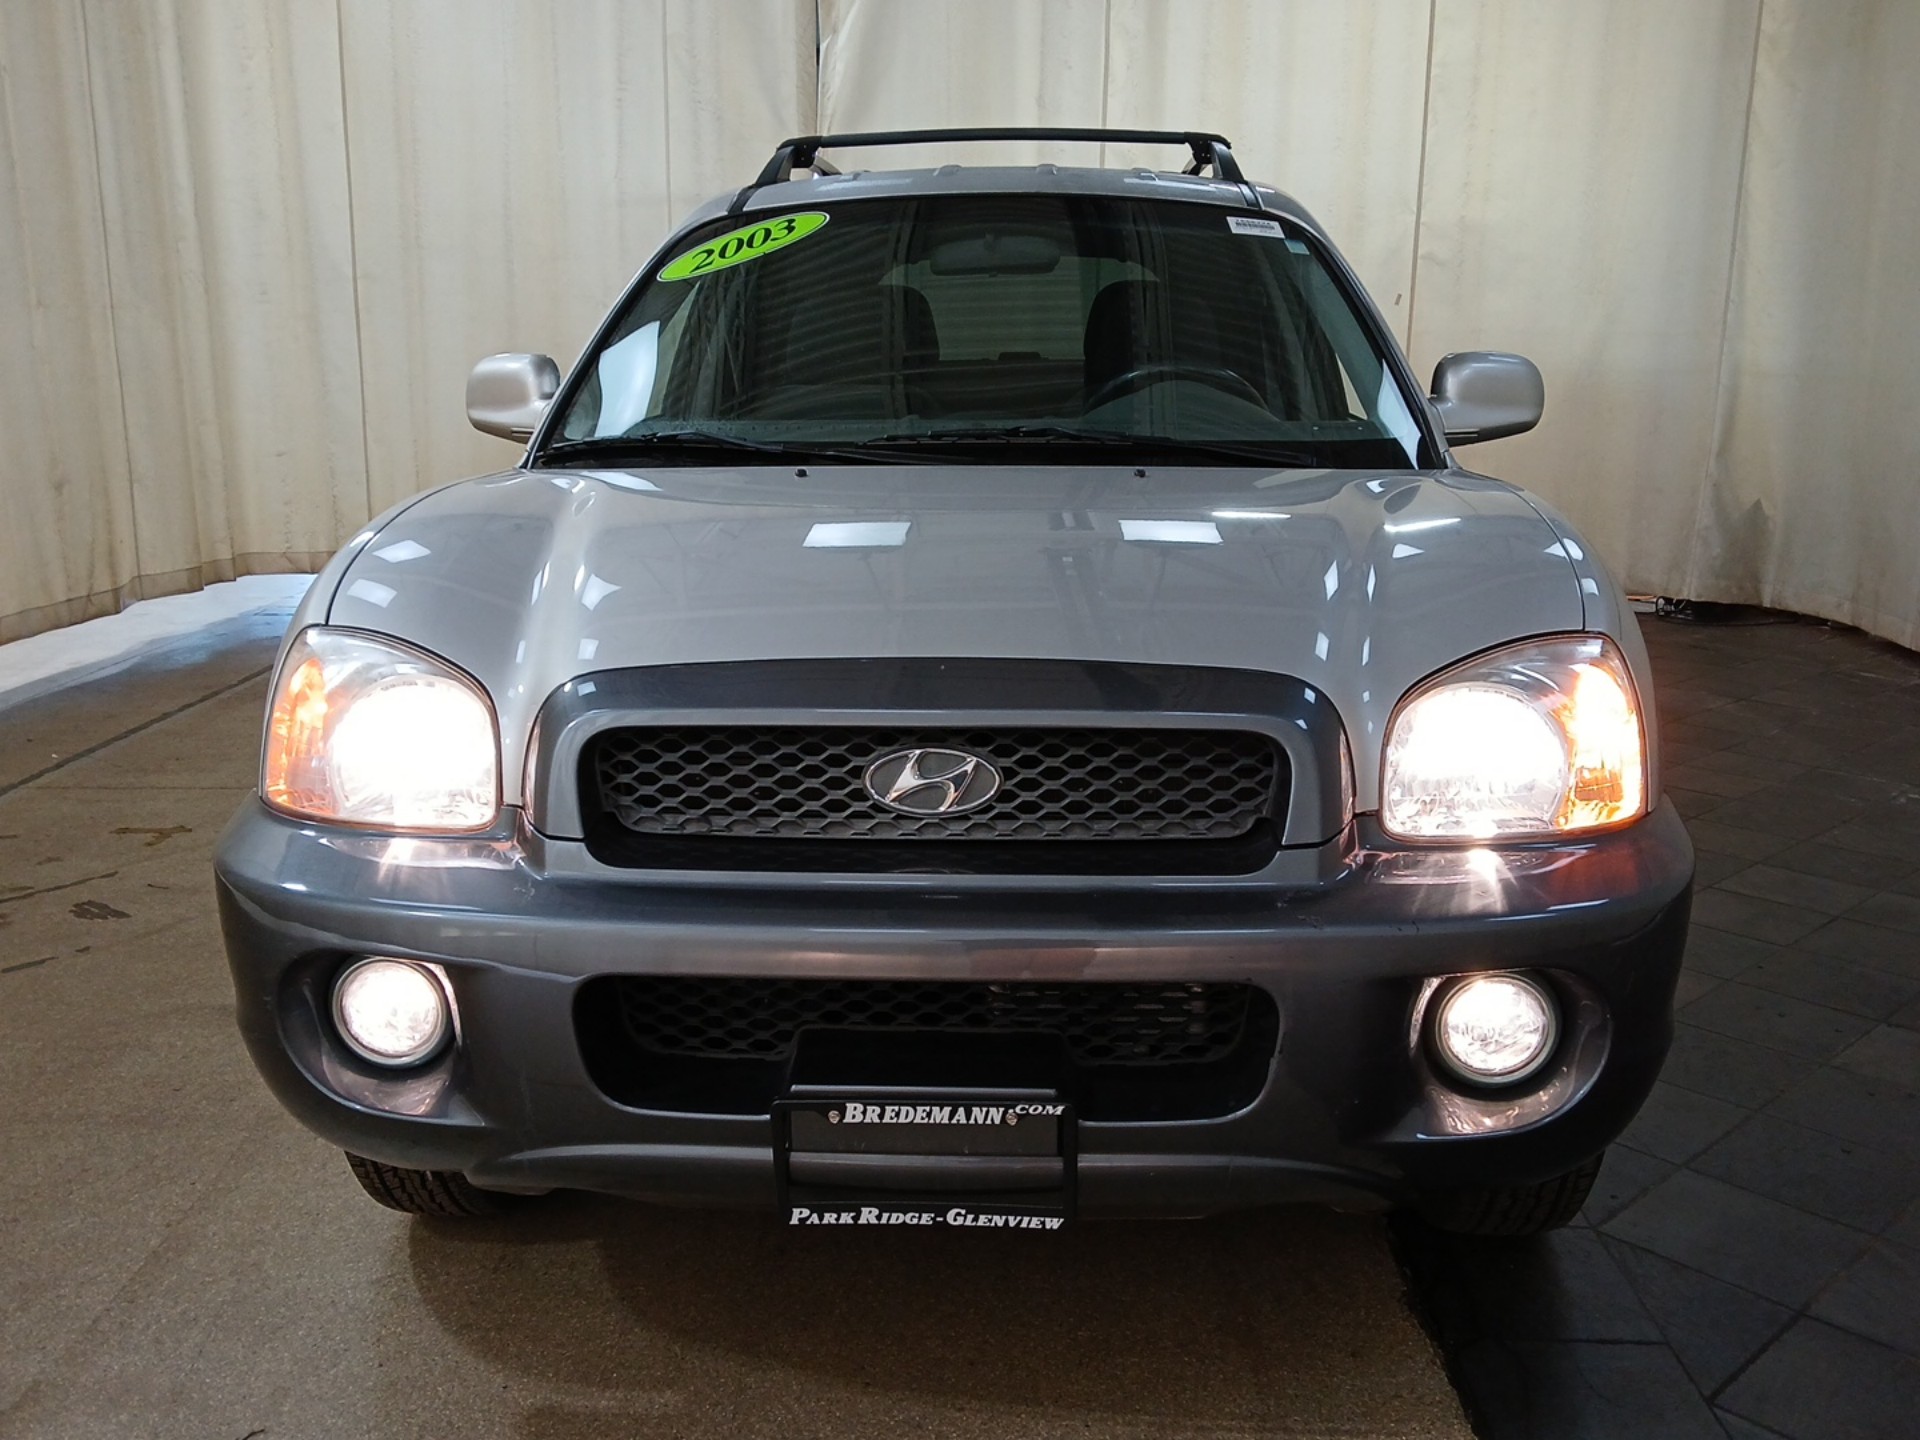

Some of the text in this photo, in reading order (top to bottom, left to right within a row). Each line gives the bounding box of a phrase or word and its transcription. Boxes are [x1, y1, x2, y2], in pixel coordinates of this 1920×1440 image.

[689, 219, 796, 274] 2003
[842, 1102, 1005, 1125] BREDEMANN
[788, 1207, 857, 1225] PARK
